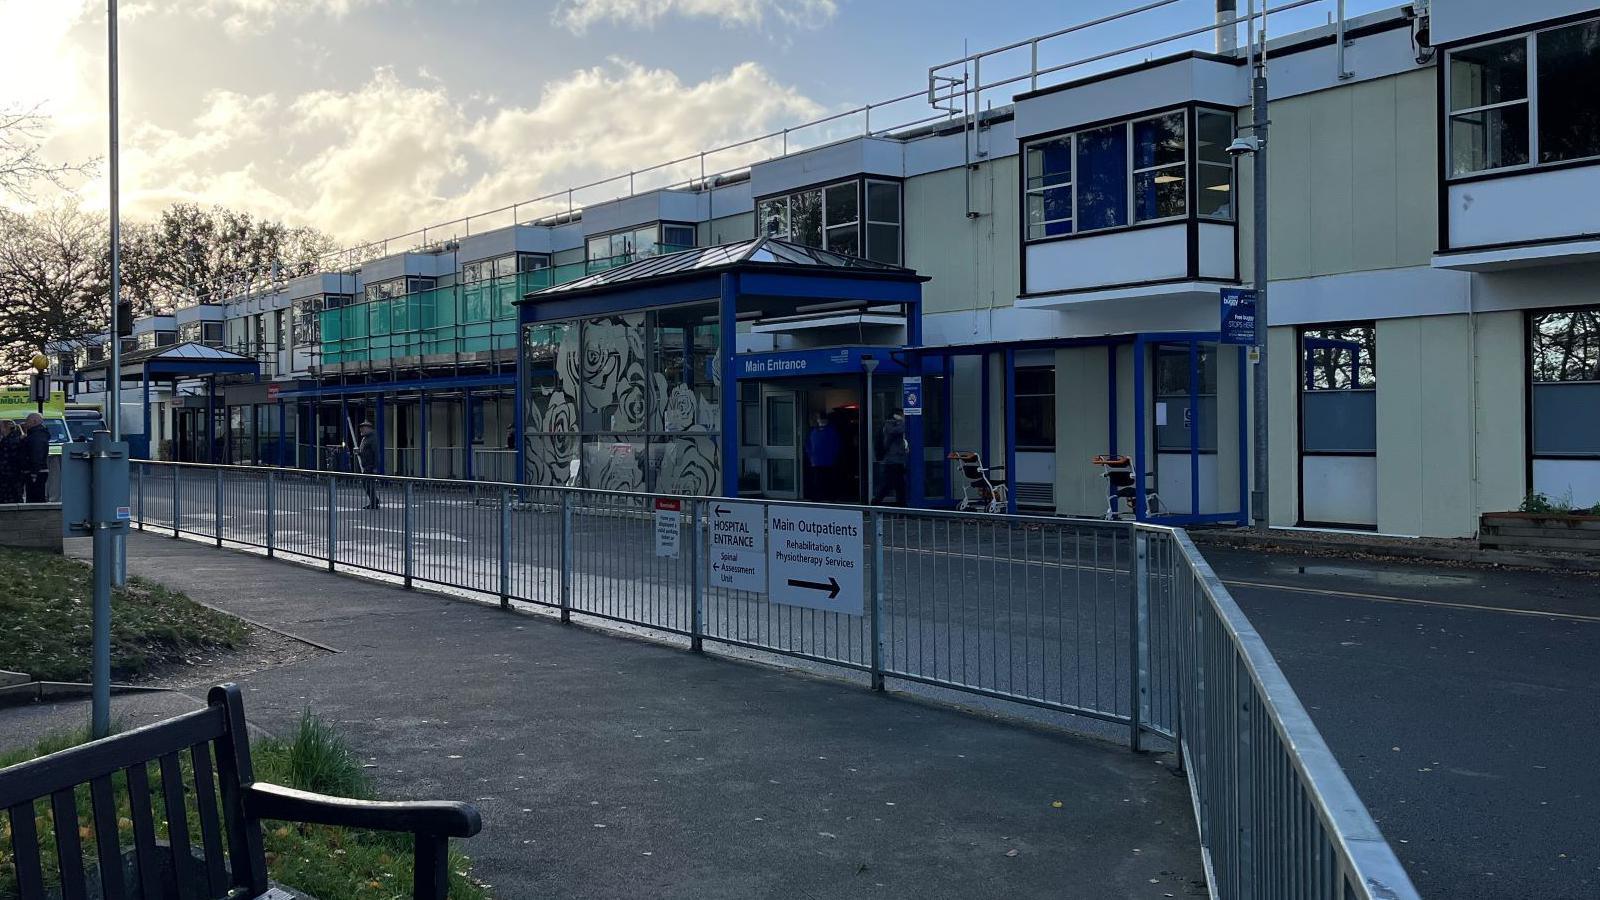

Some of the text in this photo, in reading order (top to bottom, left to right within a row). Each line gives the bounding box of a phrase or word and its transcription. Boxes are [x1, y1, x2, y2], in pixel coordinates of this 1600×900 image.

[745, 359, 807, 373] Main Entrance
[714, 521, 749, 534] HOSPITAL
[772, 518, 858, 537] Main Outpatients
[714, 534, 754, 548] ENTRANCE
[786, 539, 842, 553] Rehabilitation &
[720, 552, 738, 562] Spinal
[776, 551, 854, 568] Physiotherapy Services
[721, 562, 755, 575] Assessment
[720, 574, 733, 584] Unit
